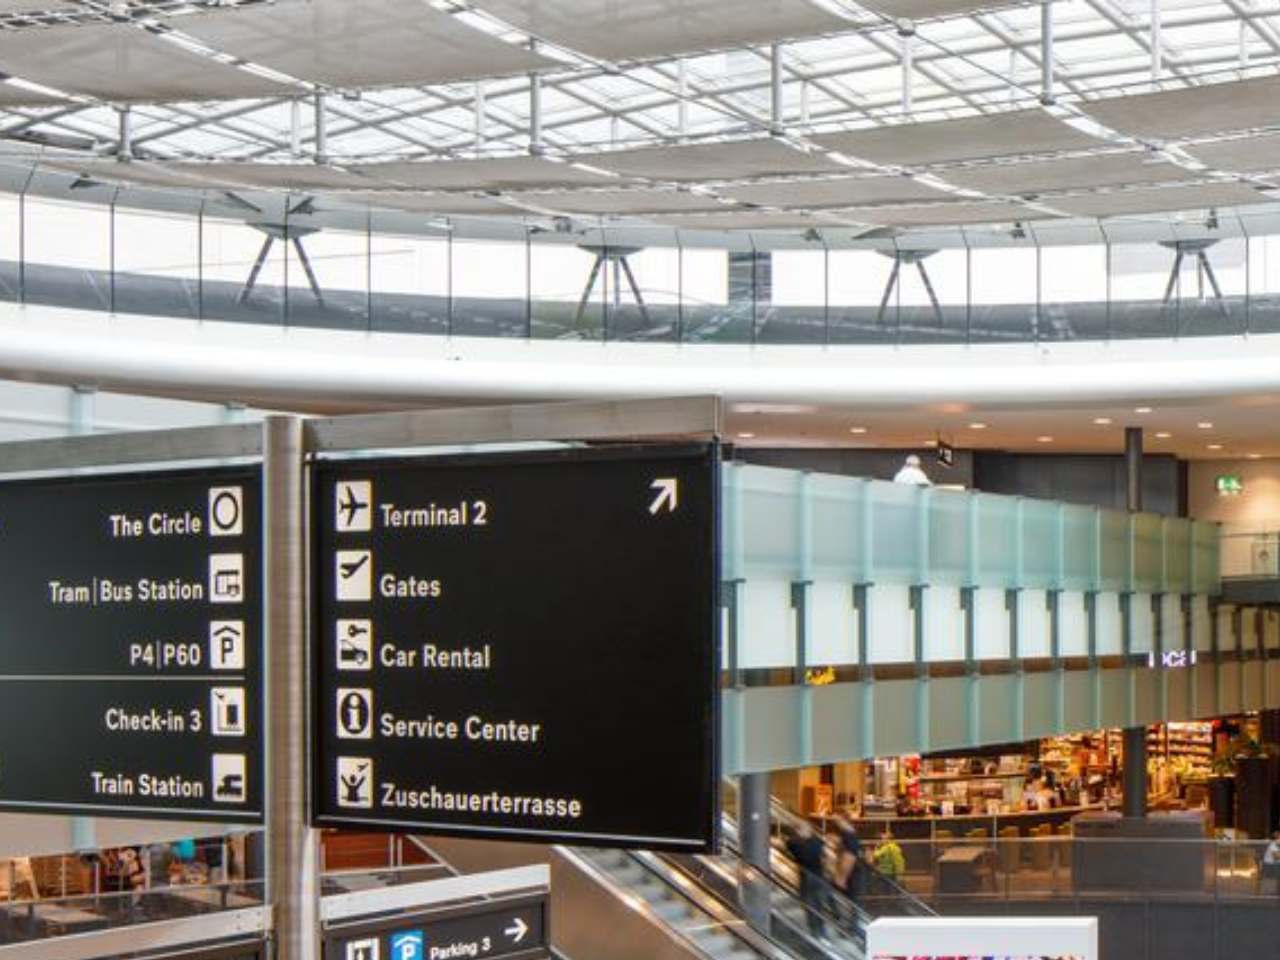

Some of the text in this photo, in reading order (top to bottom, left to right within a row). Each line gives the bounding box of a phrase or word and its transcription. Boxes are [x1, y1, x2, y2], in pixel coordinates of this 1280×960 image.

[110, 513, 201, 536] The Circle
[380, 500, 488, 526] Terminal 2
[138, 579, 203, 601] Station
[380, 574, 441, 597] Gates
[380, 644, 491, 669] Car Rental
[106, 708, 201, 733] Check-in 3
[380, 713, 540, 742] Service Center
[92, 773, 204, 798] Train Station
[381, 782, 581, 818] Zuschauerterrasse
[481, 937, 491, 952] 3
